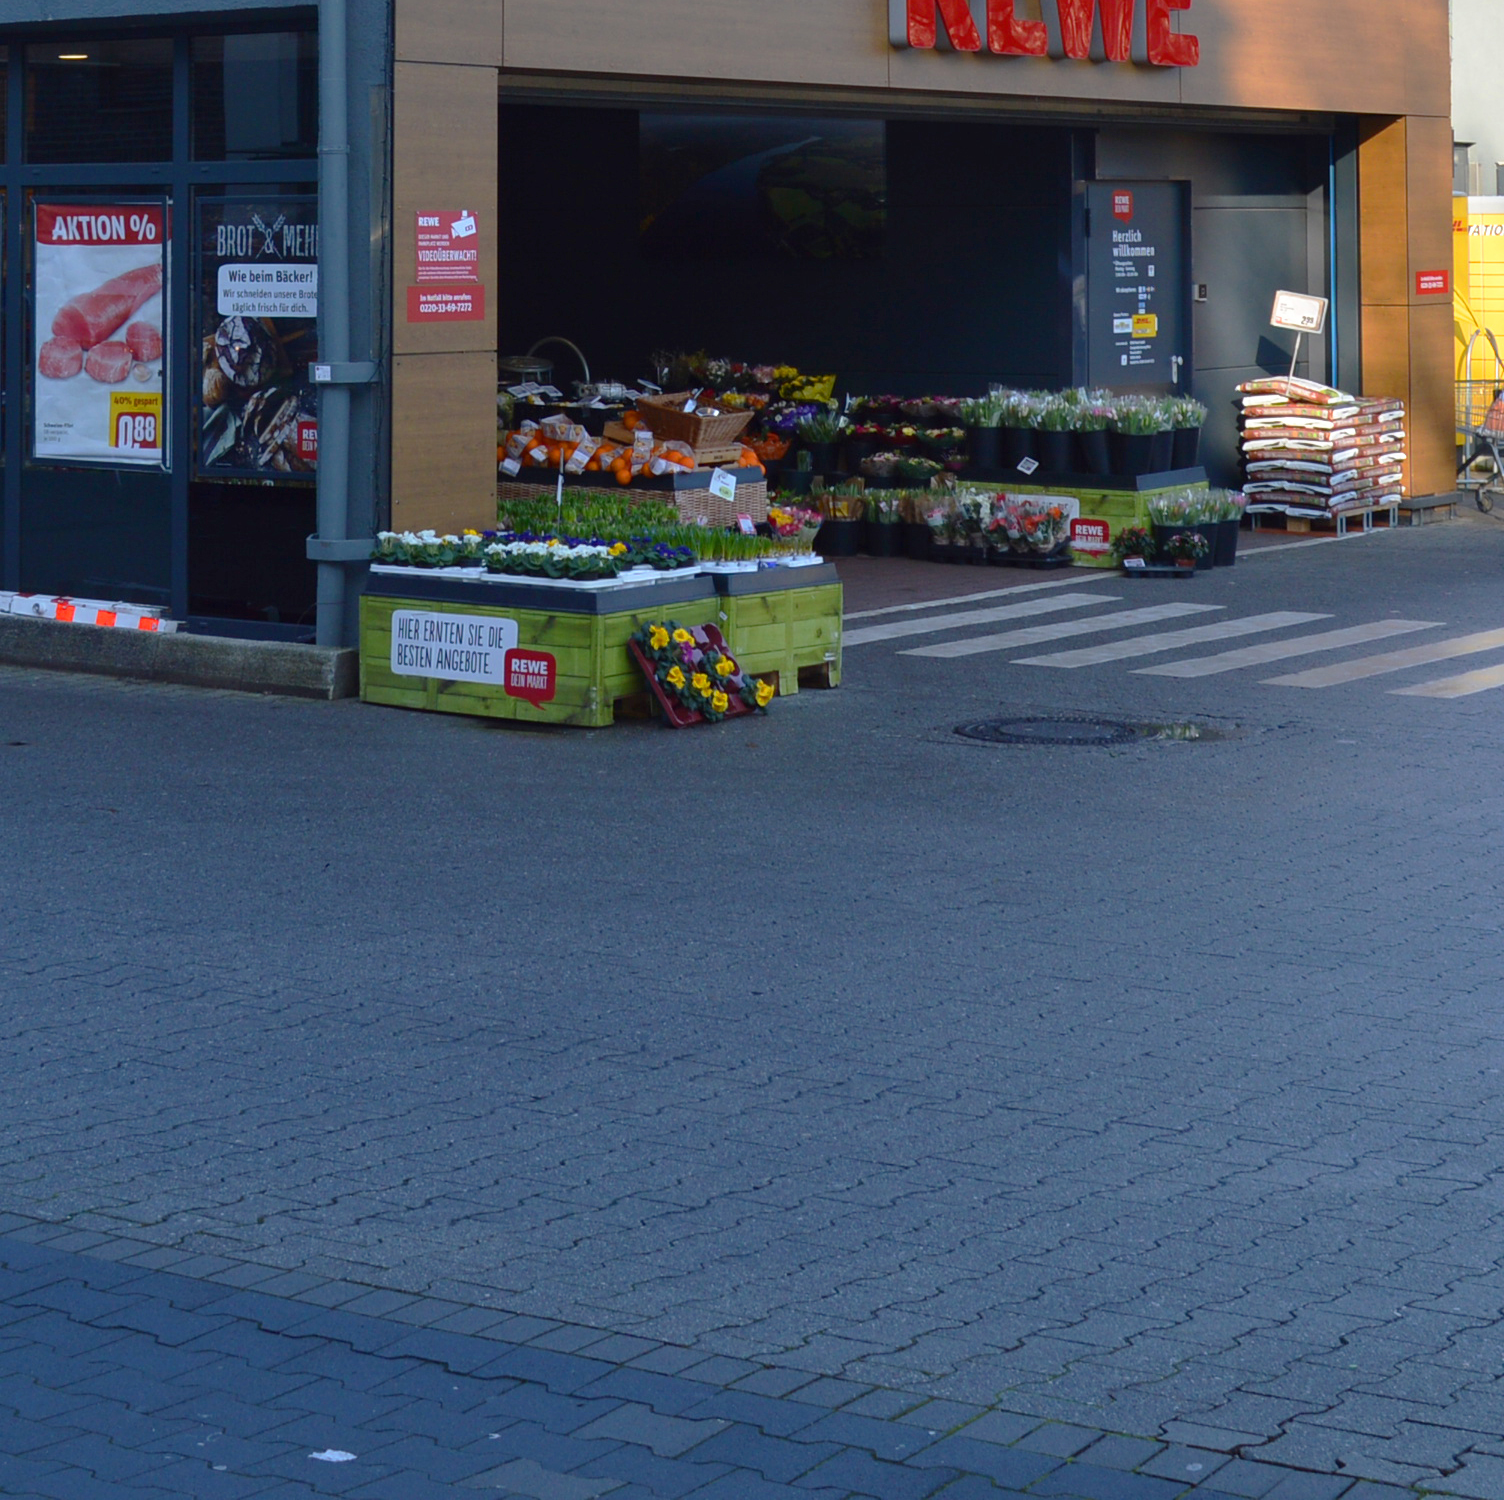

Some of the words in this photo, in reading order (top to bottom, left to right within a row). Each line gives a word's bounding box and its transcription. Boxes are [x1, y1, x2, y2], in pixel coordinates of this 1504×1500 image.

[52, 214, 126, 241] AKTION
[129, 213, 156, 241] %
[418, 216, 440, 227] REWE
[217, 224, 255, 257] BROT
[264, 228, 274, 254] &
[283, 224, 318, 257] MEH
[1112, 229, 1142, 242] Herzlich
[418, 247, 477, 262] VIDEOÜBERWACHT!
[1112, 244, 1155, 257] willkommen
[228, 269, 247, 283] Wie
[249, 269, 273, 283] beim
[276, 269, 313, 283] Bäcker!
[223, 288, 235, 298] Wir
[236, 288, 272, 299] schneiden
[274, 291, 297, 299] unsere
[232, 302, 256, 314] täglich
[258, 302, 279, 312] frisch
[279, 303, 289, 312] für
[291, 303, 309, 313] dich.
[114, 396, 133, 406] 40%
[133, 396, 159, 407] gespart
[118, 415, 156, 449] 0.88
[1075, 524, 1104, 536] REWE
[397, 617, 420, 642] HIER
[423, 619, 465, 645] ERNTEN
[468, 623, 485, 647] SIE
[488, 626, 504, 649] DIE
[397, 643, 433, 669] BESTEN
[435, 648, 493, 675] ANGEBOTE.
[511, 658, 549, 675] REWE
[510, 673, 526, 688] DEIN
[526, 674, 548, 690] MARKT
